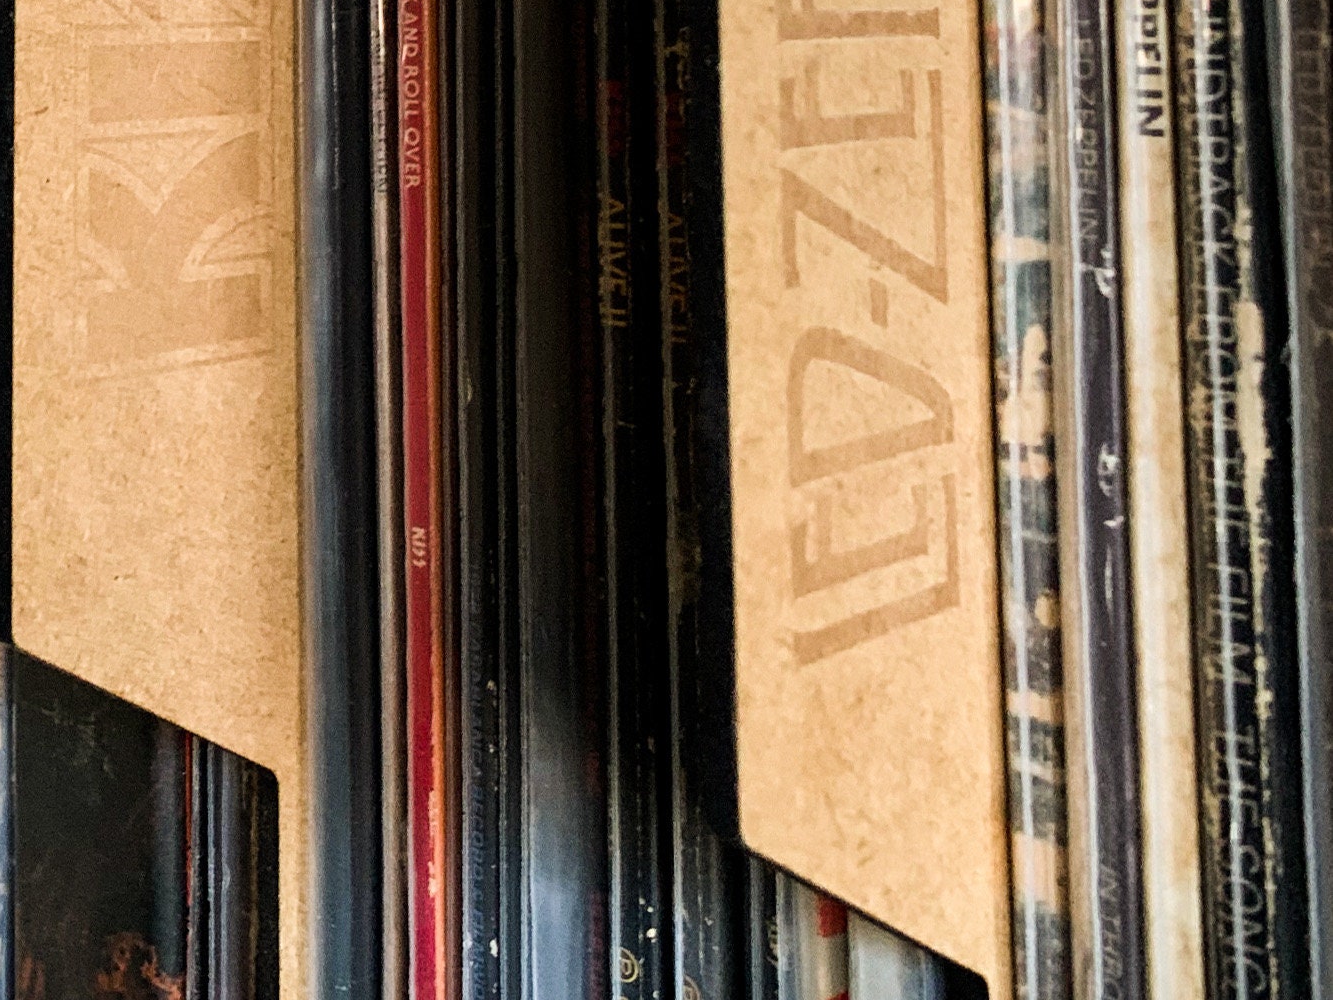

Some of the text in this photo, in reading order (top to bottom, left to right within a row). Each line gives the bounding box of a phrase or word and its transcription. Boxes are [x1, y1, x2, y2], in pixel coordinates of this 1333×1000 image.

[402, 12, 419, 58] AND
[403, 65, 420, 120] ROLL
[404, 126, 422, 188] OVER
[1074, 88, 1099, 242] ZEPPELIN
